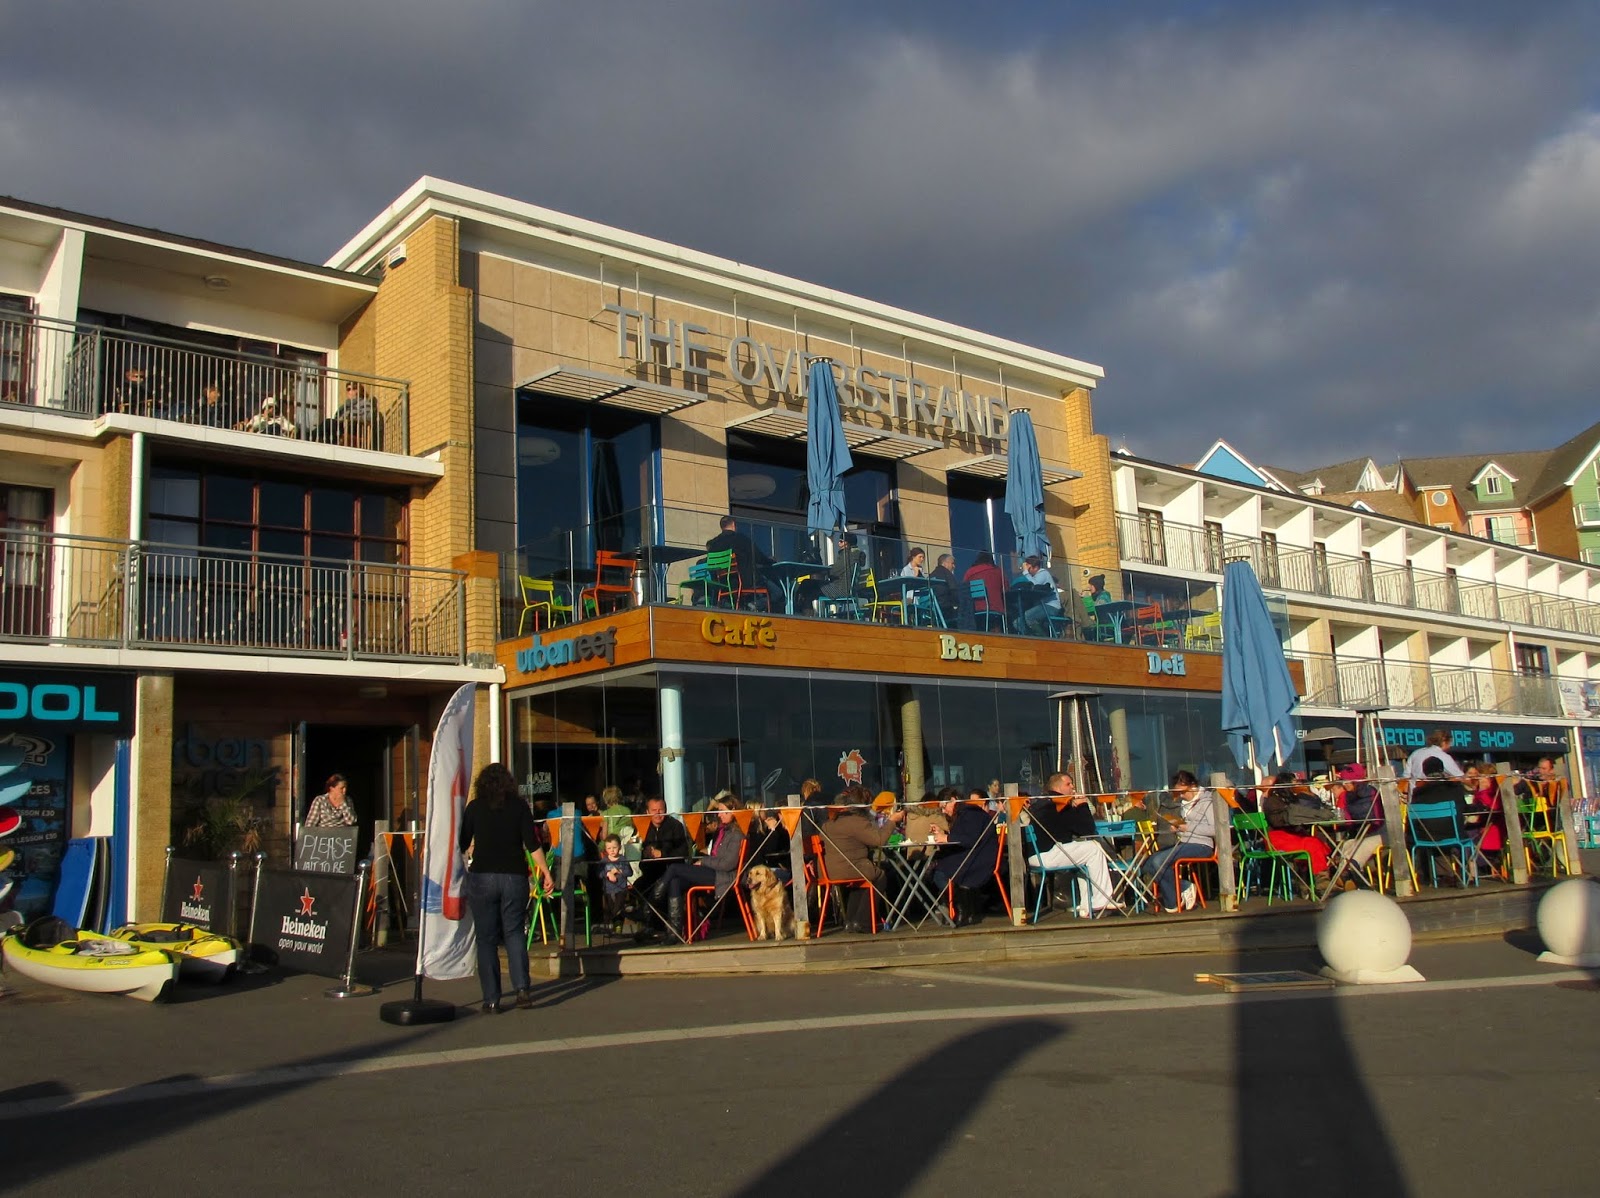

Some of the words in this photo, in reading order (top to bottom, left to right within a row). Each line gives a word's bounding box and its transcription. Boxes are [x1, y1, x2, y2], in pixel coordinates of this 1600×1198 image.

[604, 304, 710, 376] THE
[728, 337, 1008, 440] OVERSTRAND
[701, 613, 777, 649] Café
[939, 634, 984, 663] Bar
[1146, 651, 1187, 677] Deli
[1479, 730, 1514, 748] SHOP
[299, 834, 353, 861] PLEASE
[319, 860, 331, 872] TO
[333, 860, 346, 873] BE
[180, 901, 210, 922] Heineken
[281, 915, 326, 940] Heineken
[278, 938, 293, 950] open
[293, 939, 307, 952] your
[307, 943, 324, 954] world
